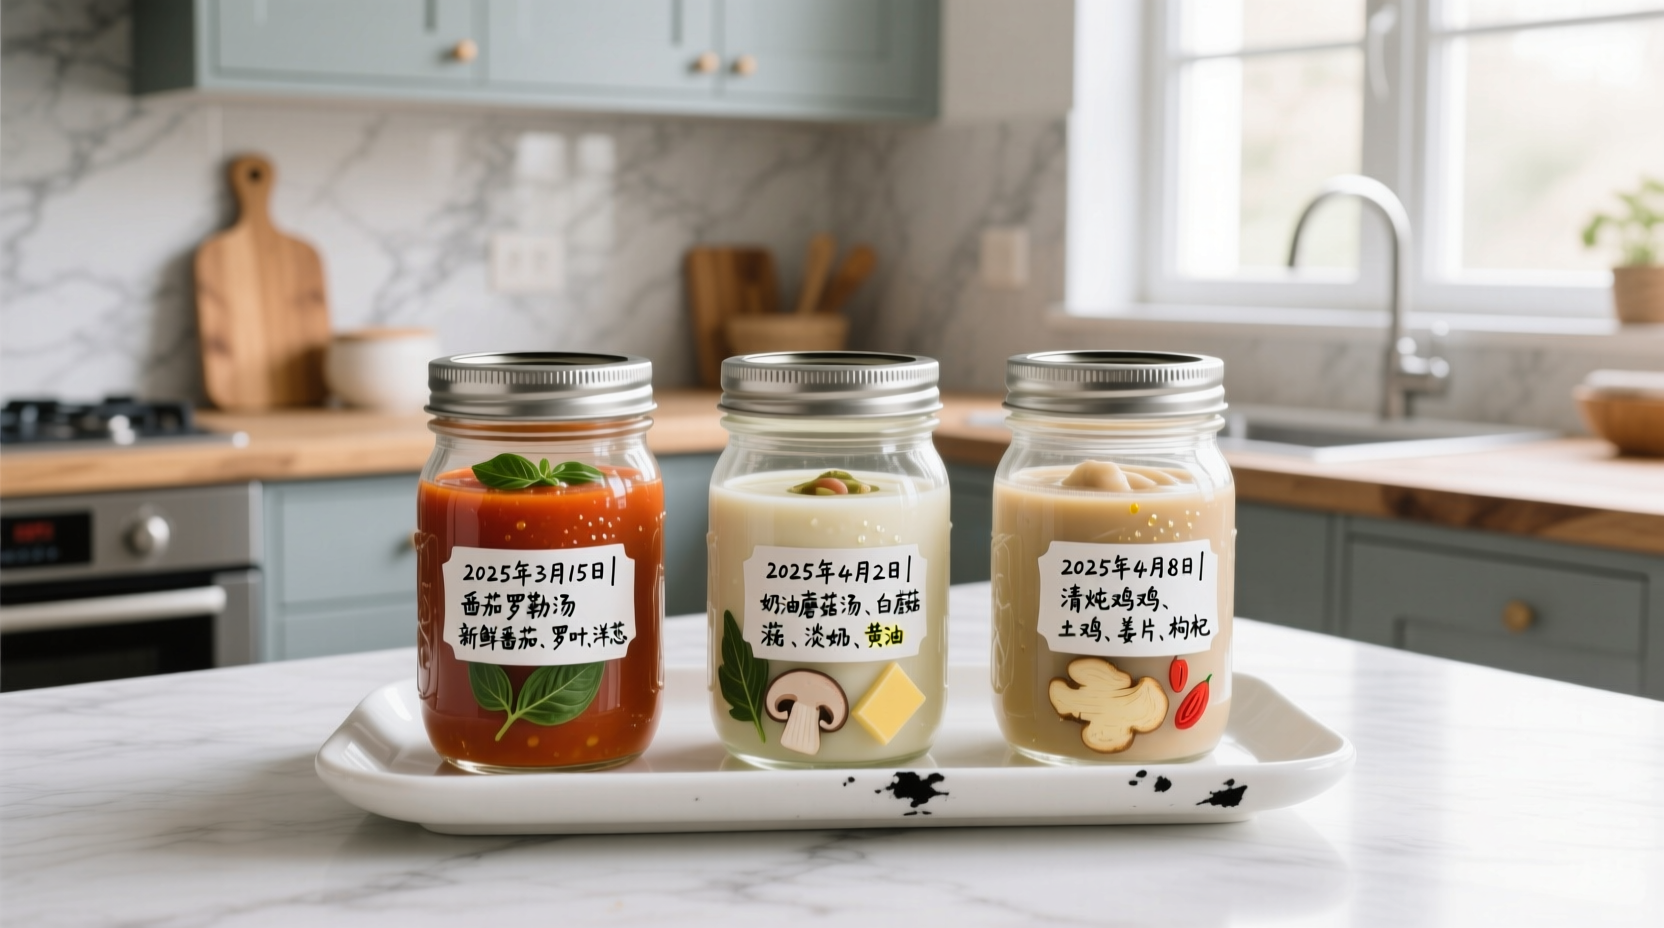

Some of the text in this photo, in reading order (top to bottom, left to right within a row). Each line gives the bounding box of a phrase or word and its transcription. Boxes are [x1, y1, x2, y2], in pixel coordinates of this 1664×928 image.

[461, 591, 576, 620] 番茄罗勒汤
[1058, 614, 1211, 644] 土鸡、姜片、枸杞
